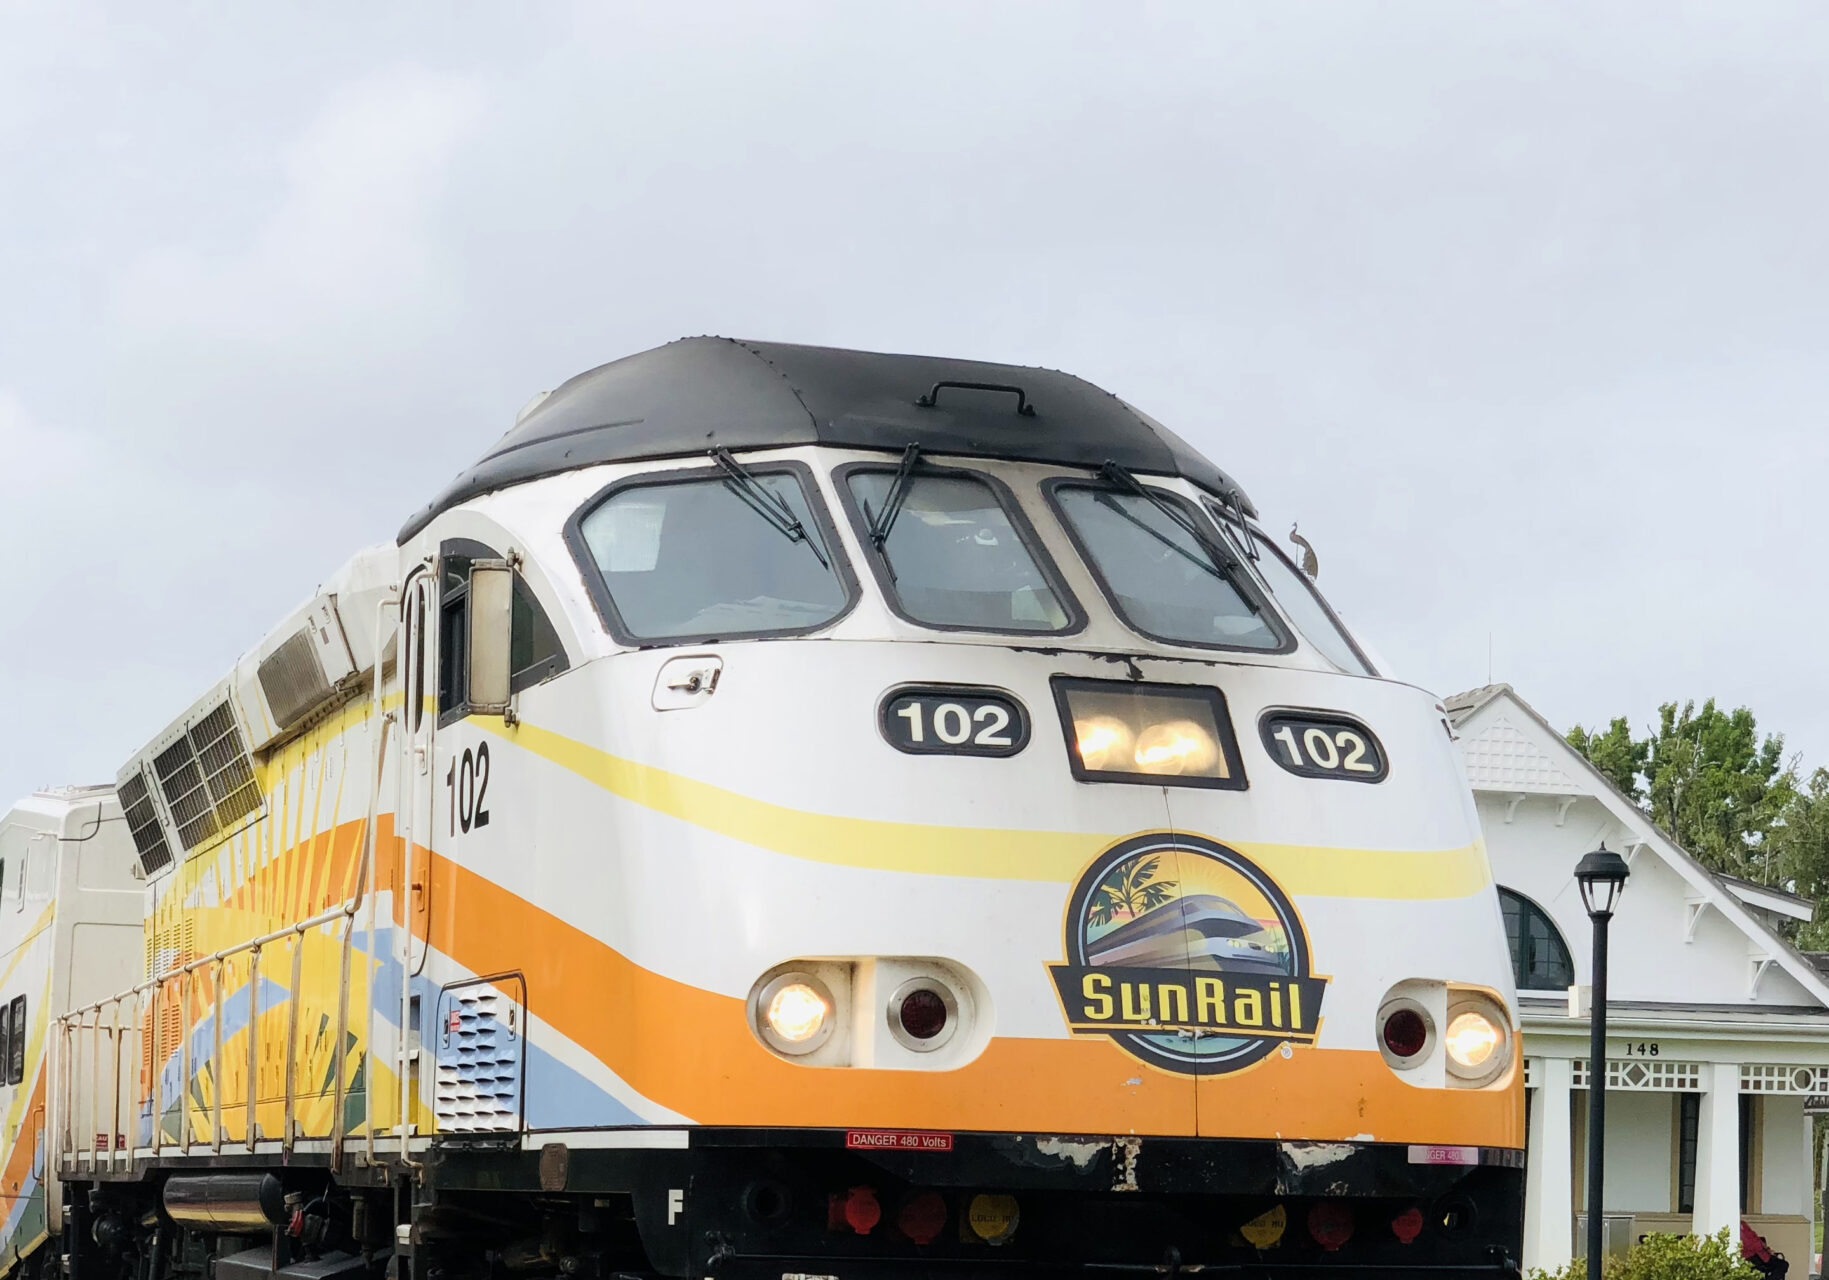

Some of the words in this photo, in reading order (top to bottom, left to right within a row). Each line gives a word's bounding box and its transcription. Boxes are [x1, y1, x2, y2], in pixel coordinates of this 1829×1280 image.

[898, 702, 1012, 746] 102
[1273, 726, 1375, 772] 102
[446, 740, 490, 838] 102
[1082, 973, 1302, 1029] SunRail
[1626, 1042, 1659, 1056] 148
[852, 1134, 897, 1146] DANGER
[900, 1136, 919, 1147] 480
[922, 1136, 947, 1148] Volts
[667, 1189, 684, 1225] F
